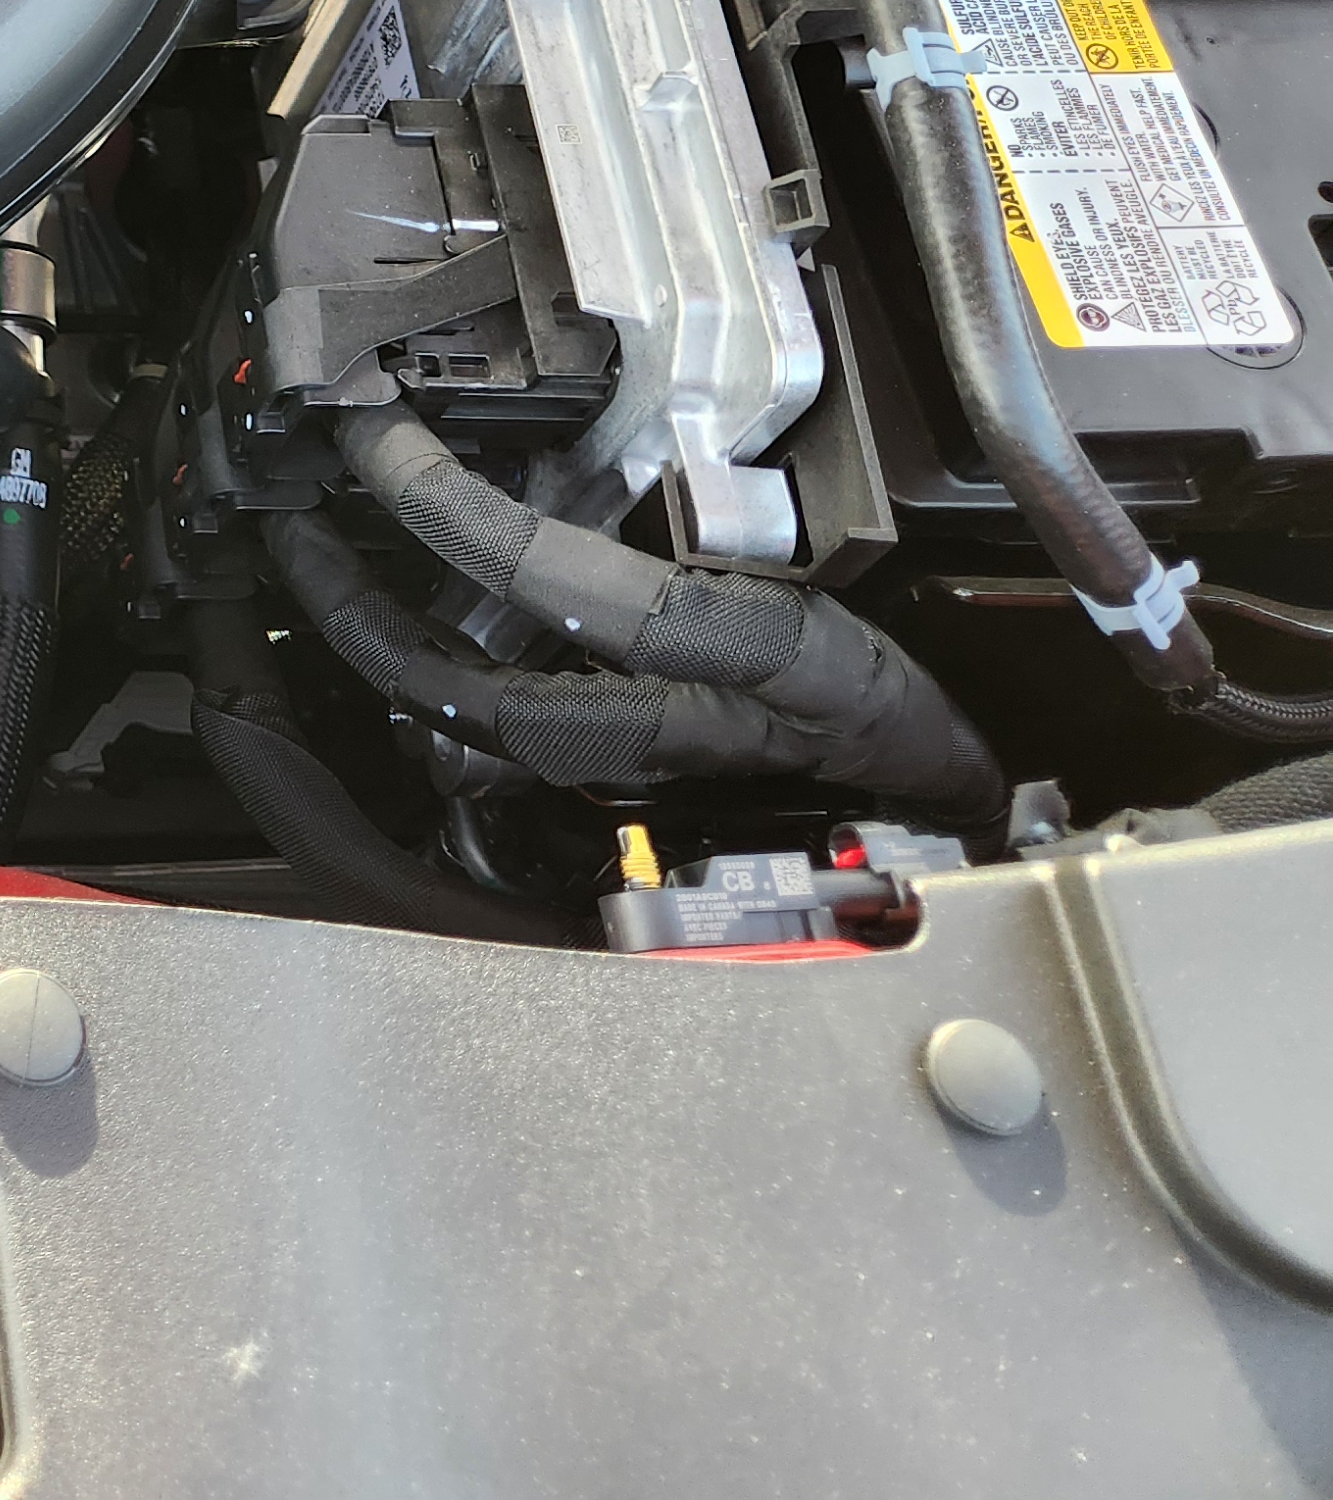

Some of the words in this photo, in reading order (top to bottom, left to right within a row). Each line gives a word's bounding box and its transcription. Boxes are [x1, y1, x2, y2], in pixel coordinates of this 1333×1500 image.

[1065, 9, 1082, 22] OUT
[1077, 3, 1100, 27] REACH
[1108, 4, 1123, 13] LA
[1113, 15, 1128, 24] DE
[971, 11, 989, 34] ACID
[1031, 5, 1056, 41] CAUSER
[1071, 23, 1089, 41] KEEP
[1001, 18, 1027, 51] SEVERE
[1053, 33, 1073, 50] DES
[1089, 28, 1103, 40] THE
[1103, 30, 1117, 40] OF
[1119, 26, 1139, 46] HORS
[1131, 29, 1146, 39] DE
[997, 38, 1017, 67] CAUSE
[1017, 54, 1032, 66] OR
[1024, 32, 1048, 66] L'ACIDE
[1044, 43, 1065, 65] PEUT
[1063, 52, 1078, 65] OU
[1126, 47, 1147, 69] TENIR
[1136, 40, 1161, 68] PORTÉE
[1067, 87, 1096, 130] FLAMMES
[1100, 83, 1130, 134] IMMEDIATELY
[1130, 87, 1150, 108] FAST.
[1087, 104, 1110, 135] FUMER
[1139, 109, 1158, 130] HELP
[1165, 90, 1191, 136] RAPIDEMENT.
[1011, 117, 1034, 151] SPARKS
[1023, 117, 1047, 150] FLAMES
[1032, 111, 1058, 150] SMOKING
[1053, 121, 1078, 156] ÉVITER
[1076, 133, 1091, 150] LES
[1088, 133, 1104, 150] LES
[1008, 144, 1024, 157] NO
[1103, 138, 1117, 150] DE
[1124, 136, 1141, 155] EYES
[1151, 131, 1176, 165] MEDICAL
[1183, 137, 1203, 167] MÉDECIN
[1136, 156, 1153, 181] FLUSH
[1151, 161, 1167, 181] WITH
[1166, 166, 1182, 181] GET
[1181, 161, 1197, 179] YEUX
[1197, 169, 1211, 179] UN
[1189, 181, 1205, 194] LES
[1075, 187, 1103, 225] INJURY.
[1105, 179, 1135, 223] PEUVENT
[1122, 179, 1153, 226] AVEUGLE.
[1195, 196, 1216, 221] RINCEZ
[1205, 180, 1231, 221] CONSULTEZ
[1049, 202, 1077, 238] GASES
[1093, 227, 1111, 241] OR
[1106, 218, 1133, 249] YEUX.
[1125, 226, 1162, 284] EXPLOSIFS
[1145, 228, 1171, 268] RENDRE
[1185, 246, 1199, 256] BE
[1205, 230, 1231, 266] BATTERIE
[1065, 240, 1103, 300] EXPLOSIVE
[1084, 244, 1109, 277] CAUSE
[1121, 252, 1142, 273] LES
[1173, 244, 1197, 280] BATTERY
[1192, 259, 1207, 280] MUST
[1195, 239, 1219, 280] RECYCLED
[1232, 260, 1247, 278] DOIT
[1059, 262, 1089, 300] SHIELD
[1103, 243, 1135, 299] BLINDNESS
[1161, 270, 1177, 284] OU
[1221, 268, 1235, 279] LA
[1099, 280, 1119, 300] CAN
[1151, 287, 1172, 309] GAZ
[1132, 276, 1166, 332] PROTÉGEZ
[1223, 298, 1240, 316] Pb
[1162, 312, 1182, 332] LES
[722, 871, 755, 892] CB
